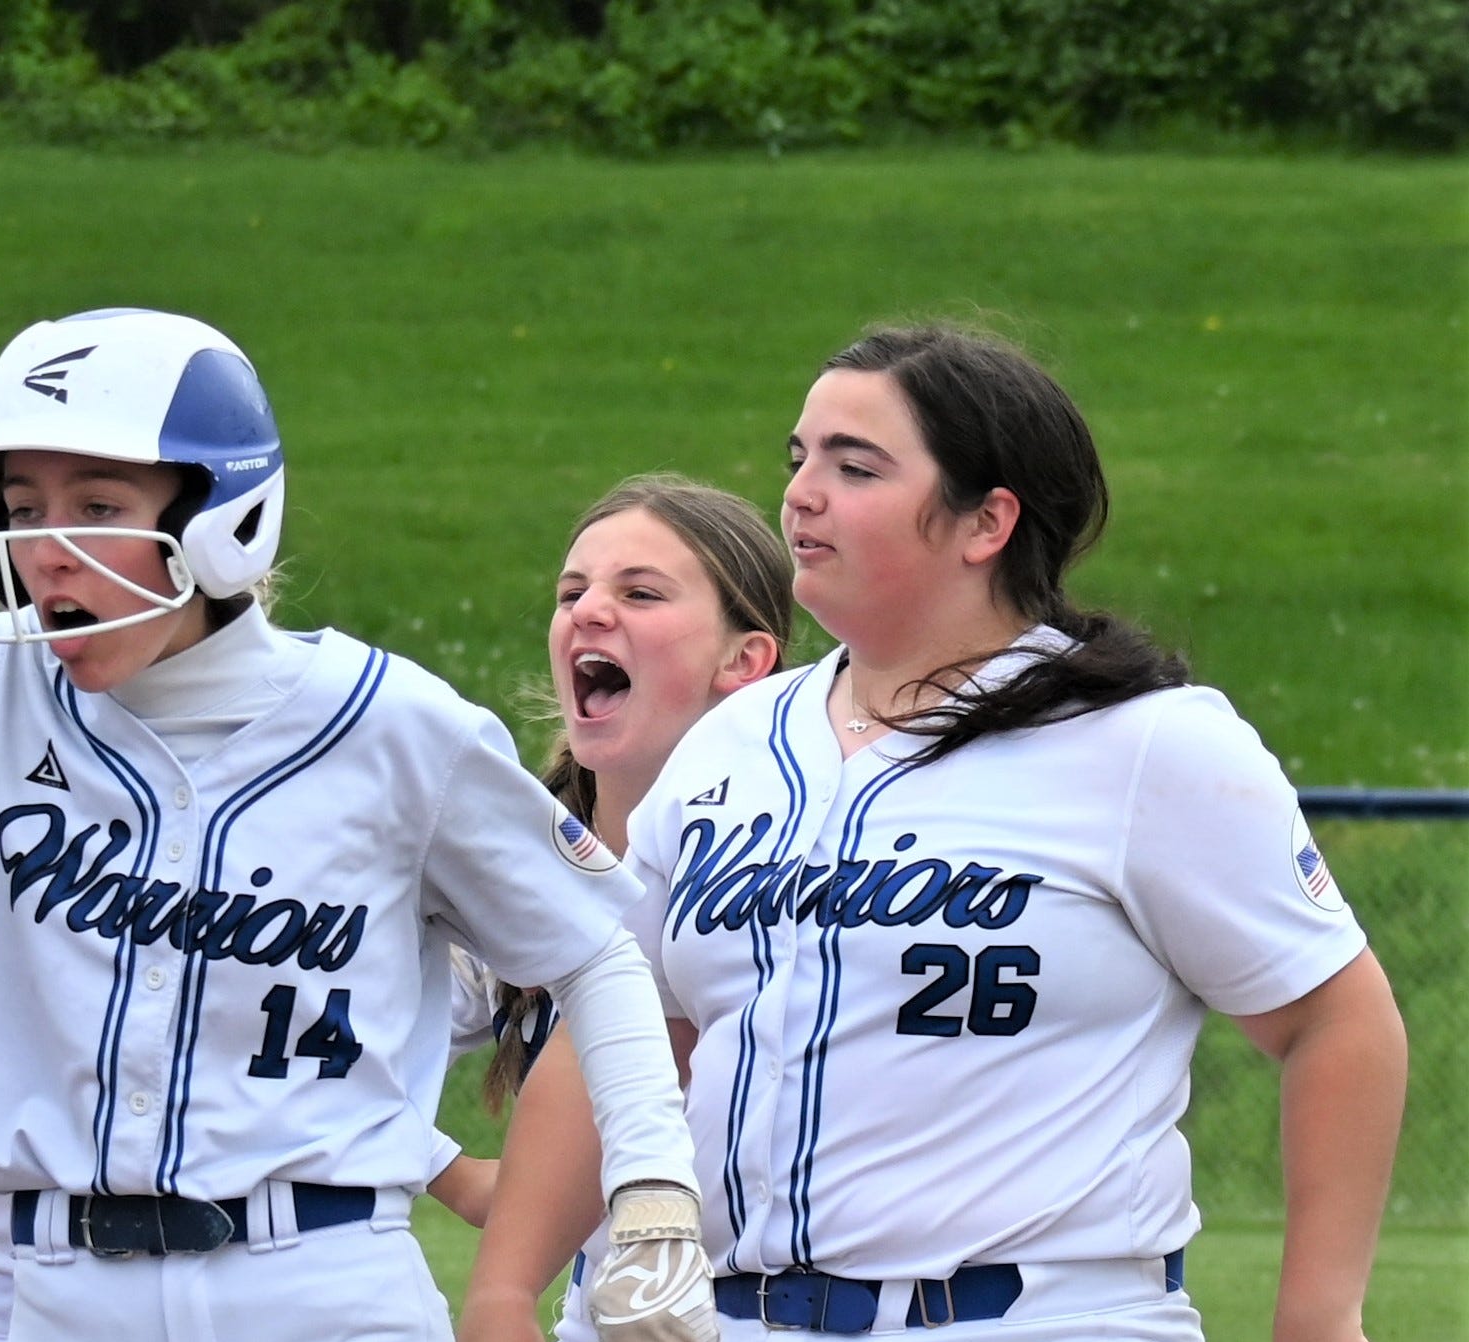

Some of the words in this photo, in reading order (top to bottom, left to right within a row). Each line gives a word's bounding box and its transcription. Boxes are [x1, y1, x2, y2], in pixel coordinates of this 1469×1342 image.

[225, 456, 269, 472] EASTON
[662, 812, 1044, 942] Warriors
[247, 984, 364, 1081] 14
[895, 943, 1041, 1038] 26
